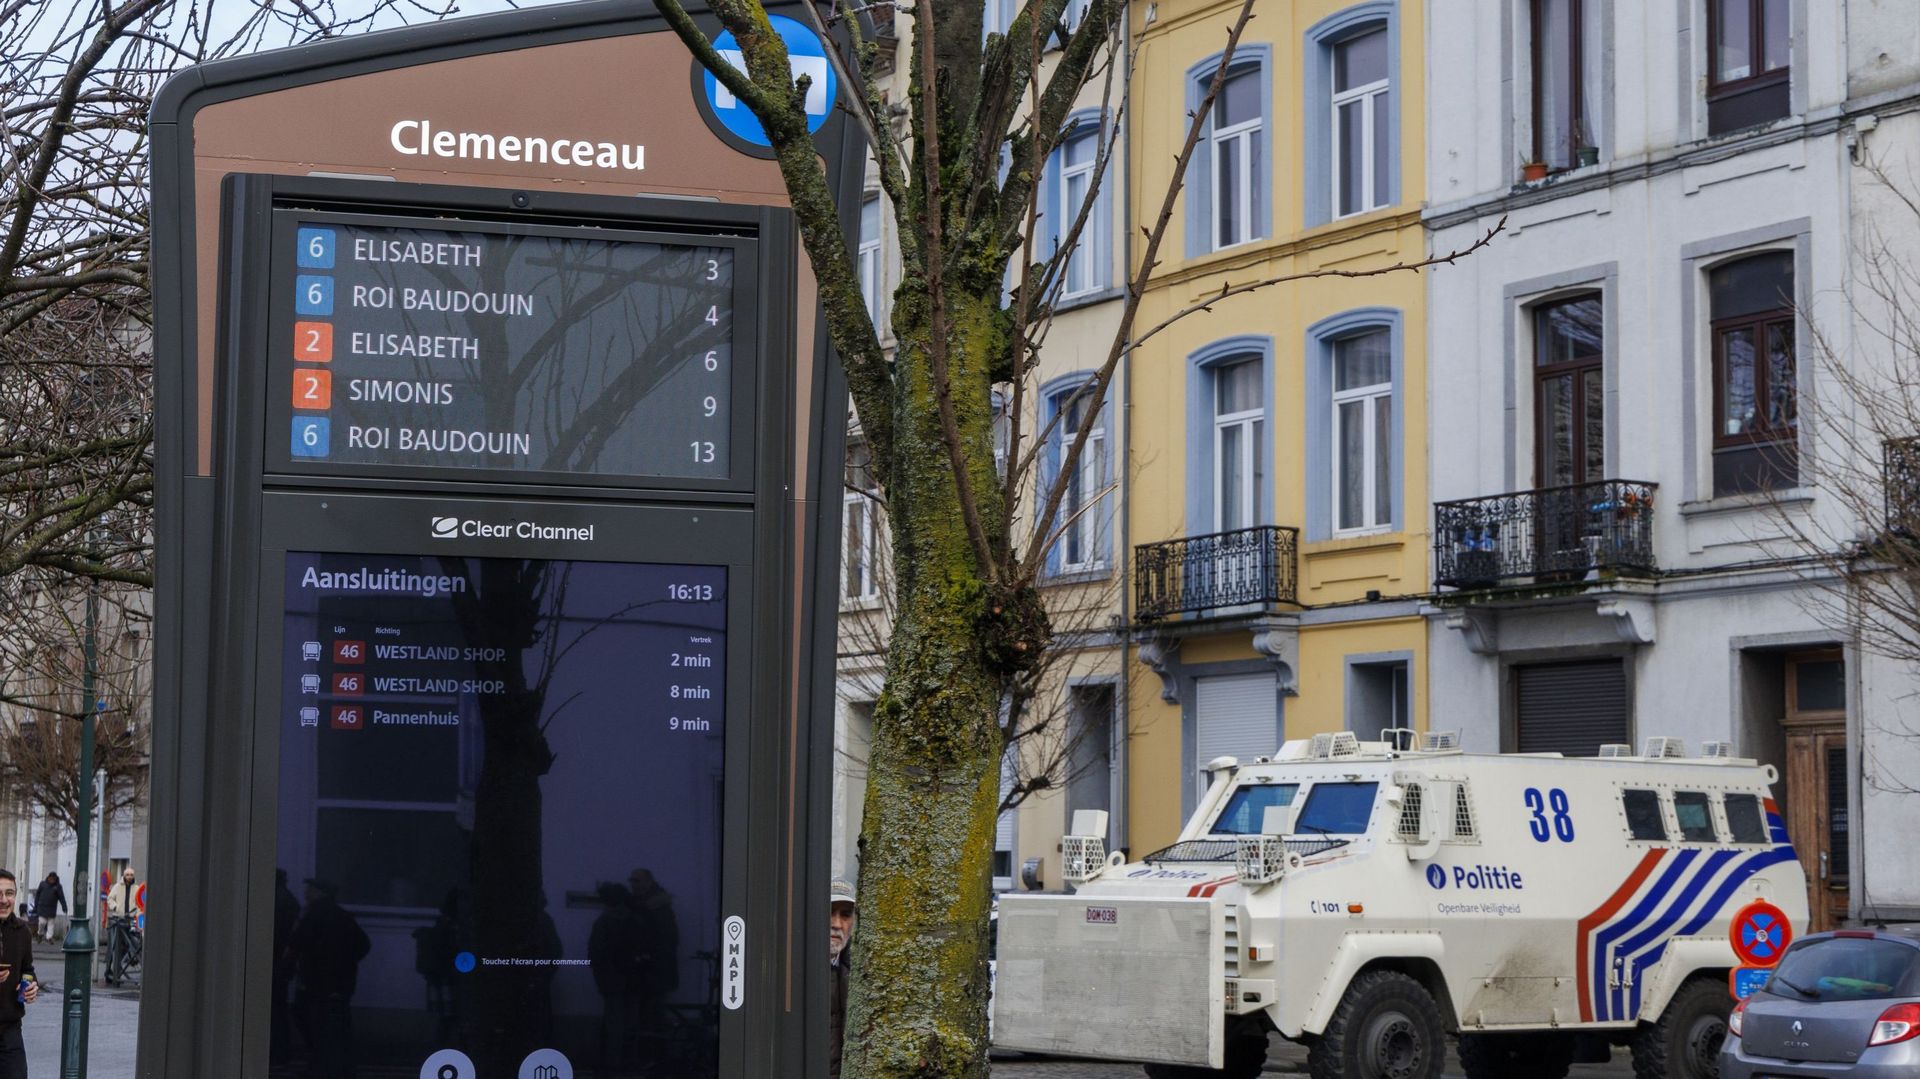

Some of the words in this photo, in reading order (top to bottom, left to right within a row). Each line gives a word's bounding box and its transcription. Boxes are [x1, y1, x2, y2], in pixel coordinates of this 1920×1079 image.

[390, 119, 646, 171] Clemenceau
[309, 238, 324, 259] 6
[353, 239, 481, 268] ELISABETH
[706, 260, 719, 281] 3
[307, 284, 323, 304] 6
[352, 285, 394, 310] ROI
[402, 287, 533, 317] BAUDOUIN
[705, 306, 719, 327] 4
[305, 331, 320, 352] 2
[350, 332, 480, 361] ELISABETH
[704, 351, 718, 373] 6
[304, 378, 319, 399] 2
[348, 379, 453, 406] SIMONIS
[703, 397, 717, 418] 9
[302, 425, 318, 446] 6
[348, 426, 390, 451] ROI
[399, 428, 531, 456] BAUDOUIN
[689, 442, 716, 464] 13
[461, 519, 512, 539] Clear
[515, 521, 594, 541] Channel
[301, 566, 466, 597] Aansluitingen
[667, 583, 713, 601] 16:13
[334, 625, 346, 634] Lijn
[375, 627, 401, 636] Richting
[690, 636, 712, 644] Vertrek
[339, 644, 359, 659] 46
[375, 644, 460, 661] WESTLAND
[463, 646, 507, 662] SHOP.
[670, 653, 680, 667] 2
[683, 653, 711, 668] min
[338, 676, 358, 691] 46
[373, 677, 459, 693] WESTLAND
[462, 679, 506, 694] SHOP.
[670, 685, 680, 699] 8
[683, 685, 711, 699] min
[337, 709, 357, 724] 46
[373, 709, 460, 726] Pannenhuis
[669, 716, 679, 730] 9
[682, 716, 710, 731] min
[1524, 787, 1575, 843] 38
[1152, 869, 1208, 879] Police
[1453, 865, 1523, 890] Politie
[1322, 903, 1340, 913] 101
[1437, 902, 1479, 914] Openbare
[1480, 903, 1521, 916] Veiligheid
[481, 957, 510, 966] Touchez
[511, 957, 534, 966] l'écran
[534, 959, 551, 967] pour
[552, 958, 592, 966] commencer
[729, 943, 740, 982] MAP
